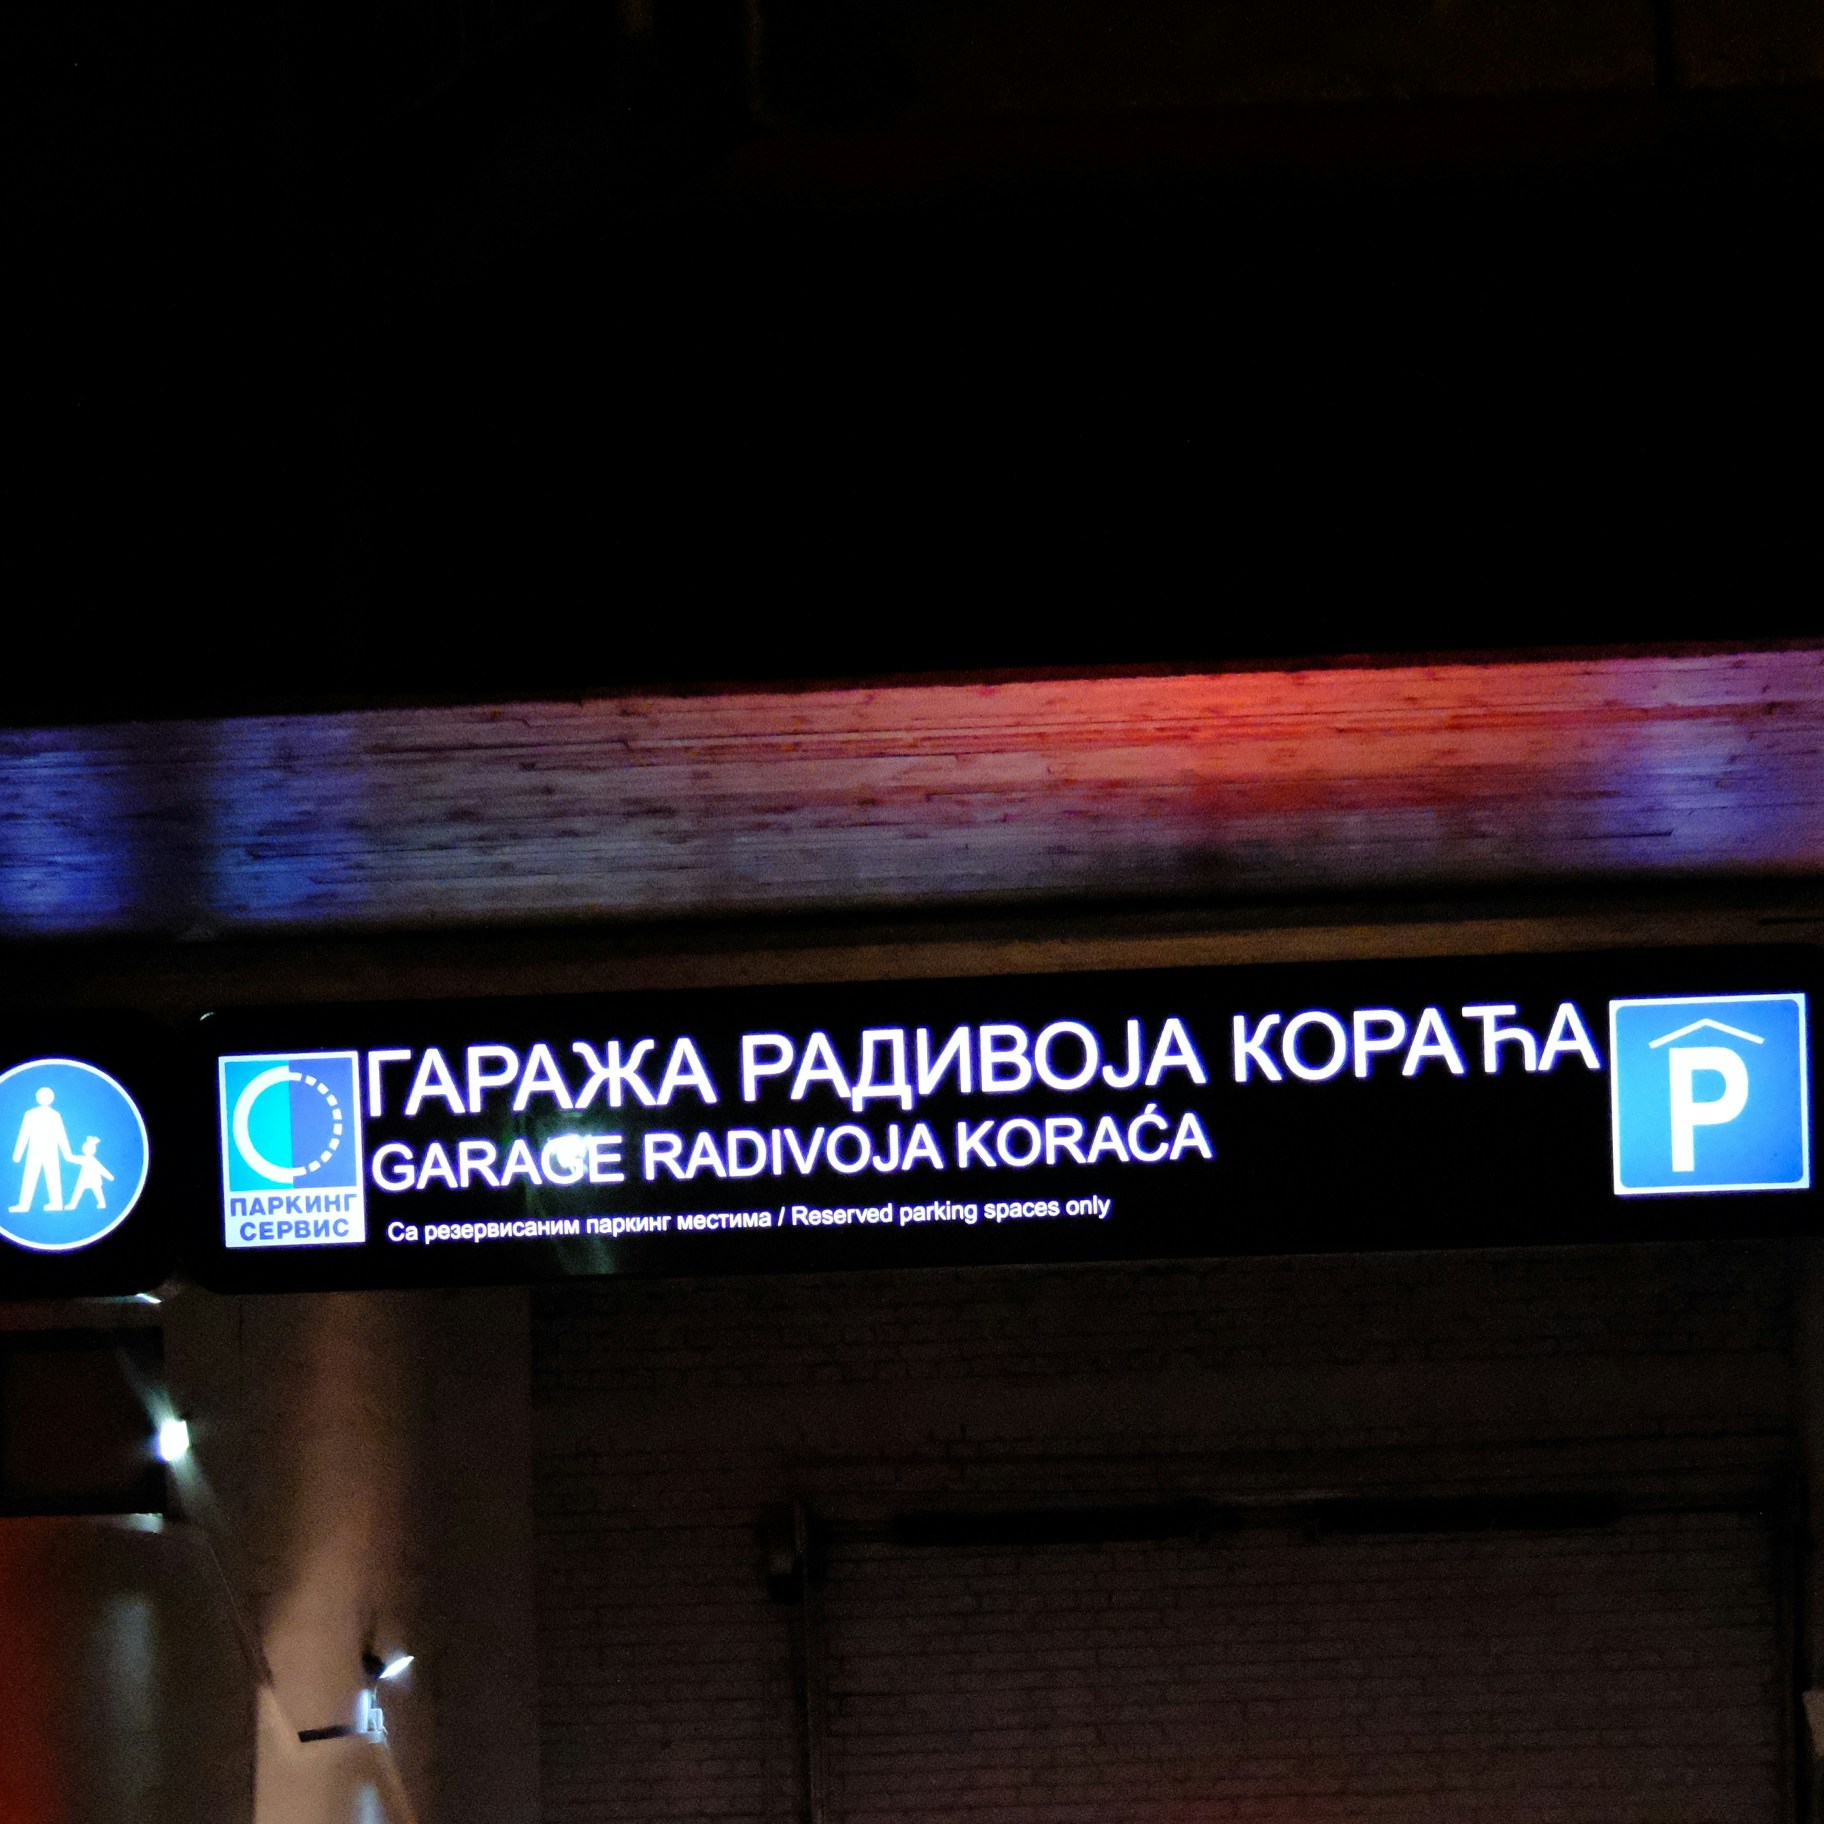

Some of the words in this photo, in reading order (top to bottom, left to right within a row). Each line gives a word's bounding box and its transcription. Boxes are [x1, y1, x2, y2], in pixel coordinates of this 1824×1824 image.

[368, 1037, 718, 1117] ГАРАЖА
[741, 1019, 1207, 1112] РАДИВОЈА
[1233, 1003, 1600, 1083] КОРАЋА
[1669, 1046, 1749, 1172] P
[372, 1133, 625, 1193] GARAGE
[644, 1122, 944, 1181] RADIVOJA
[957, 1103, 1213, 1169] KORAĆA
[230, 1193, 358, 1217] ПАРКИНГ
[239, 1218, 350, 1242] СЕРВИС
[387, 1222, 418, 1243] Са
[424, 1217, 579, 1245] резервисаним
[587, 1214, 673, 1236] паркинг
[677, 1210, 772, 1231] местима
[792, 1202, 893, 1226] Reserved
[900, 1200, 978, 1227] parking
[984, 1198, 1060, 1220] spaces
[1066, 1195, 1111, 1220] only
